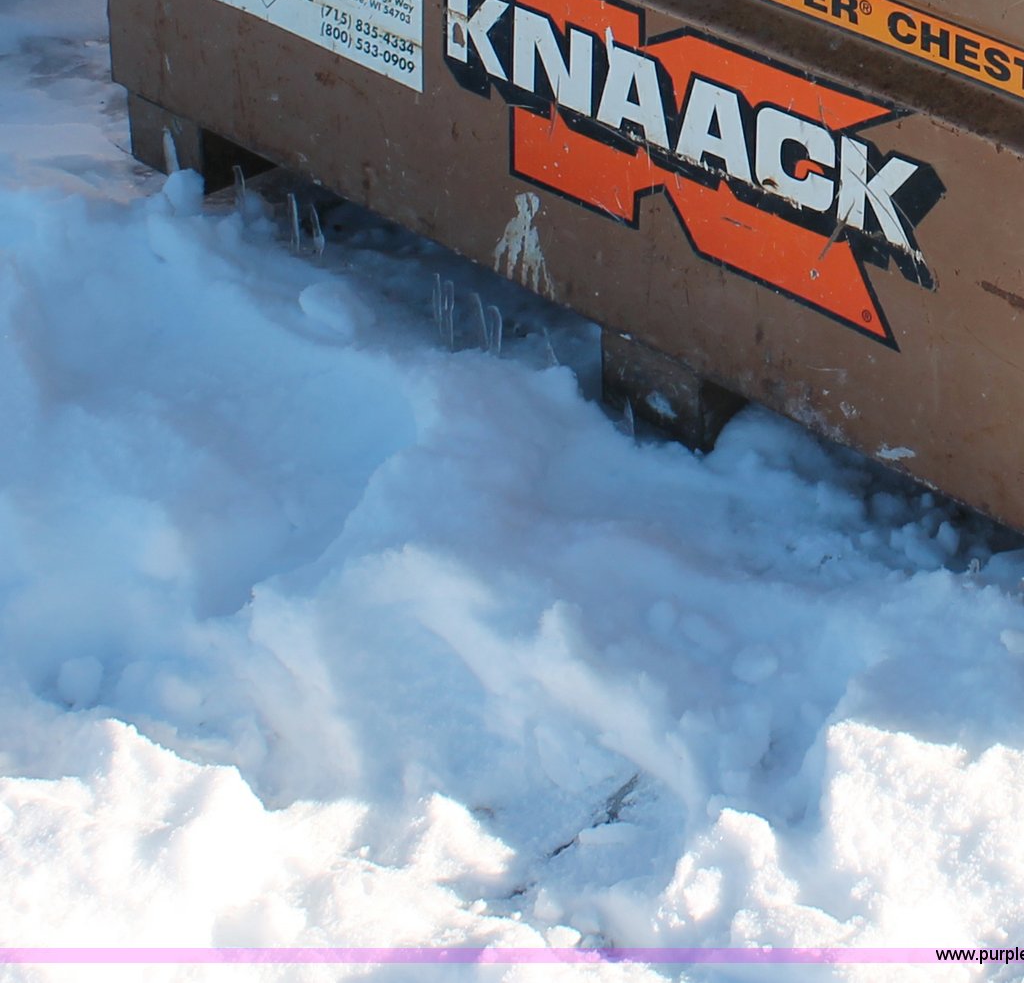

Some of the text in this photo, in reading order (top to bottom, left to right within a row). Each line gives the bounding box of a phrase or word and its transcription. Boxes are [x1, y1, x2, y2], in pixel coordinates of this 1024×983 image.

[320, 4, 415, 56] (715) 835-4334
[369, 0, 382, 11] WI
[383, 5, 412, 25] 54703
[320, 21, 416, 75] (800) 533-0909
